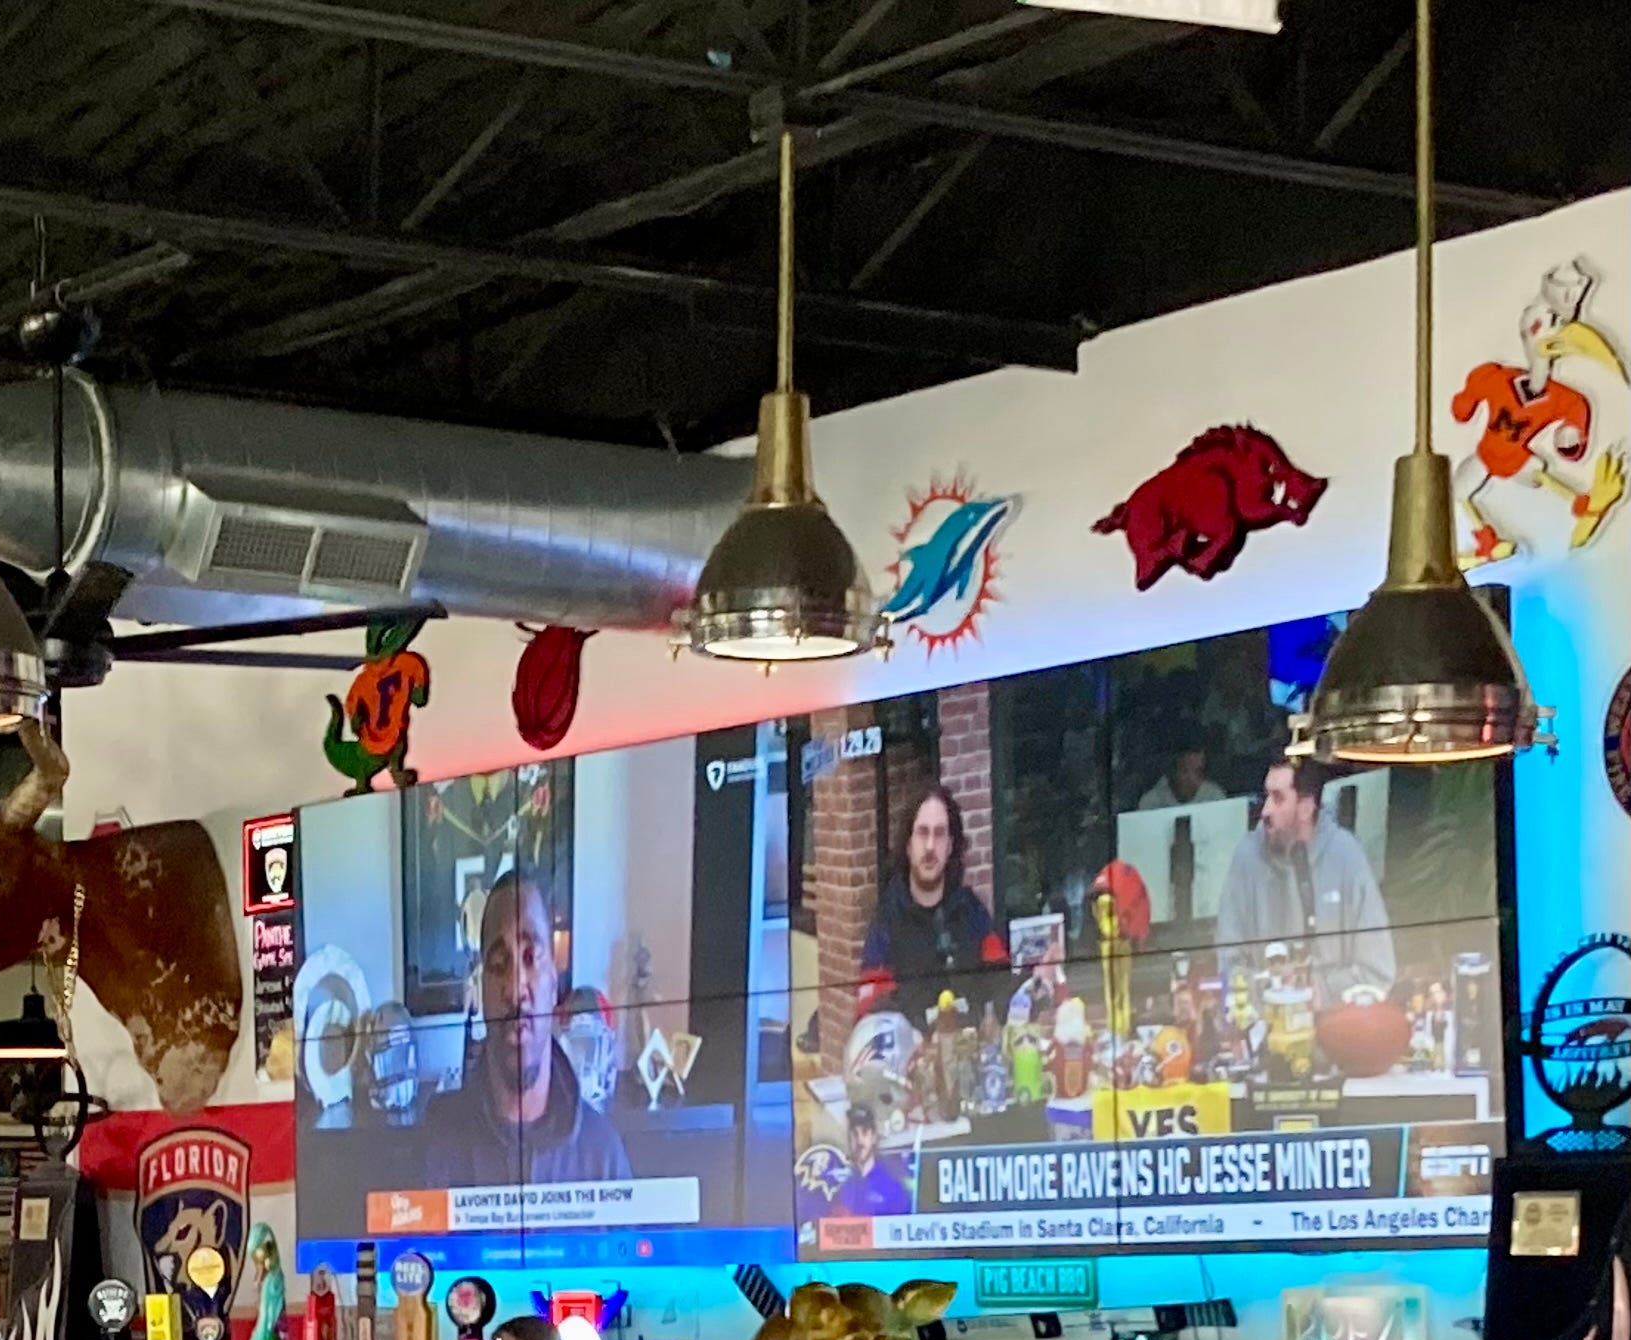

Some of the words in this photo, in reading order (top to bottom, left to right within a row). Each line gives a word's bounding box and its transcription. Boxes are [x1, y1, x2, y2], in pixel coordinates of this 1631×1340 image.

[1488, 405, 1531, 443] M
[147, 1144, 239, 1190] FLORIDA
[937, 1153, 1058, 1204] BALTIMORE
[1060, 1145, 1153, 1200] RAVENS
[1157, 1146, 1191, 1197] HC
[1193, 1141, 1270, 1195] JESSE
[1274, 1137, 1371, 1192] MINTER
[1420, 1144, 1491, 1180] ESPN
[907, 1220, 949, 1241] Levi's
[951, 1217, 1014, 1240] Stadium
[1019, 1217, 1032, 1237] in
[1037, 1215, 1083, 1238] Santa
[1143, 1213, 1224, 1236] California
[1291, 1211, 1324, 1232] The
[1329, 1210, 1359, 1231] Los
[1364, 1207, 1439, 1233] Angeles
[984, 1267, 1009, 1295] PIG
[1011, 1265, 1057, 1294] BEACH
[1059, 1265, 1086, 1294] BBQ
